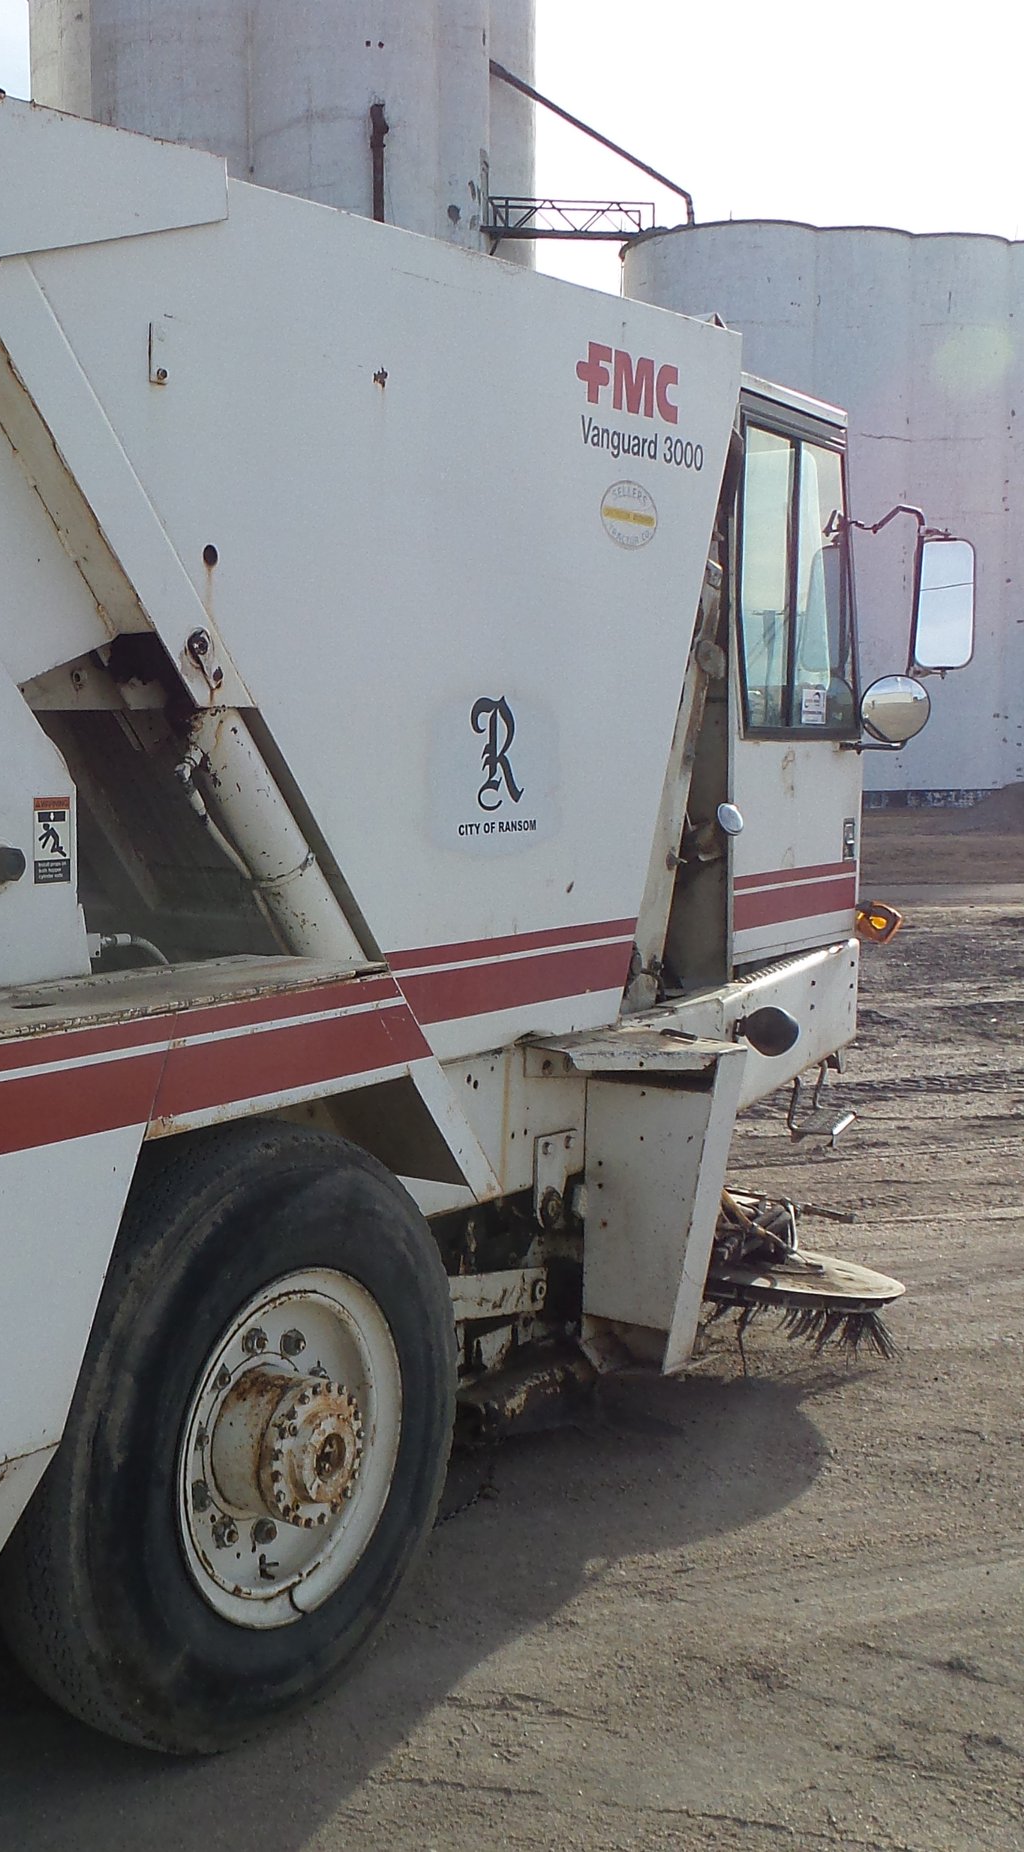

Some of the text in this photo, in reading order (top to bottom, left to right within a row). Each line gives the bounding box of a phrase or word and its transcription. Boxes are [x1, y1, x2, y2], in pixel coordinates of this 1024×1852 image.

[576, 341, 678, 425] FMC
[581, 414, 703, 471] Vanguard 3000
[471, 696, 524, 811] R
[458, 819, 537, 836] CITY OF RANSOM
